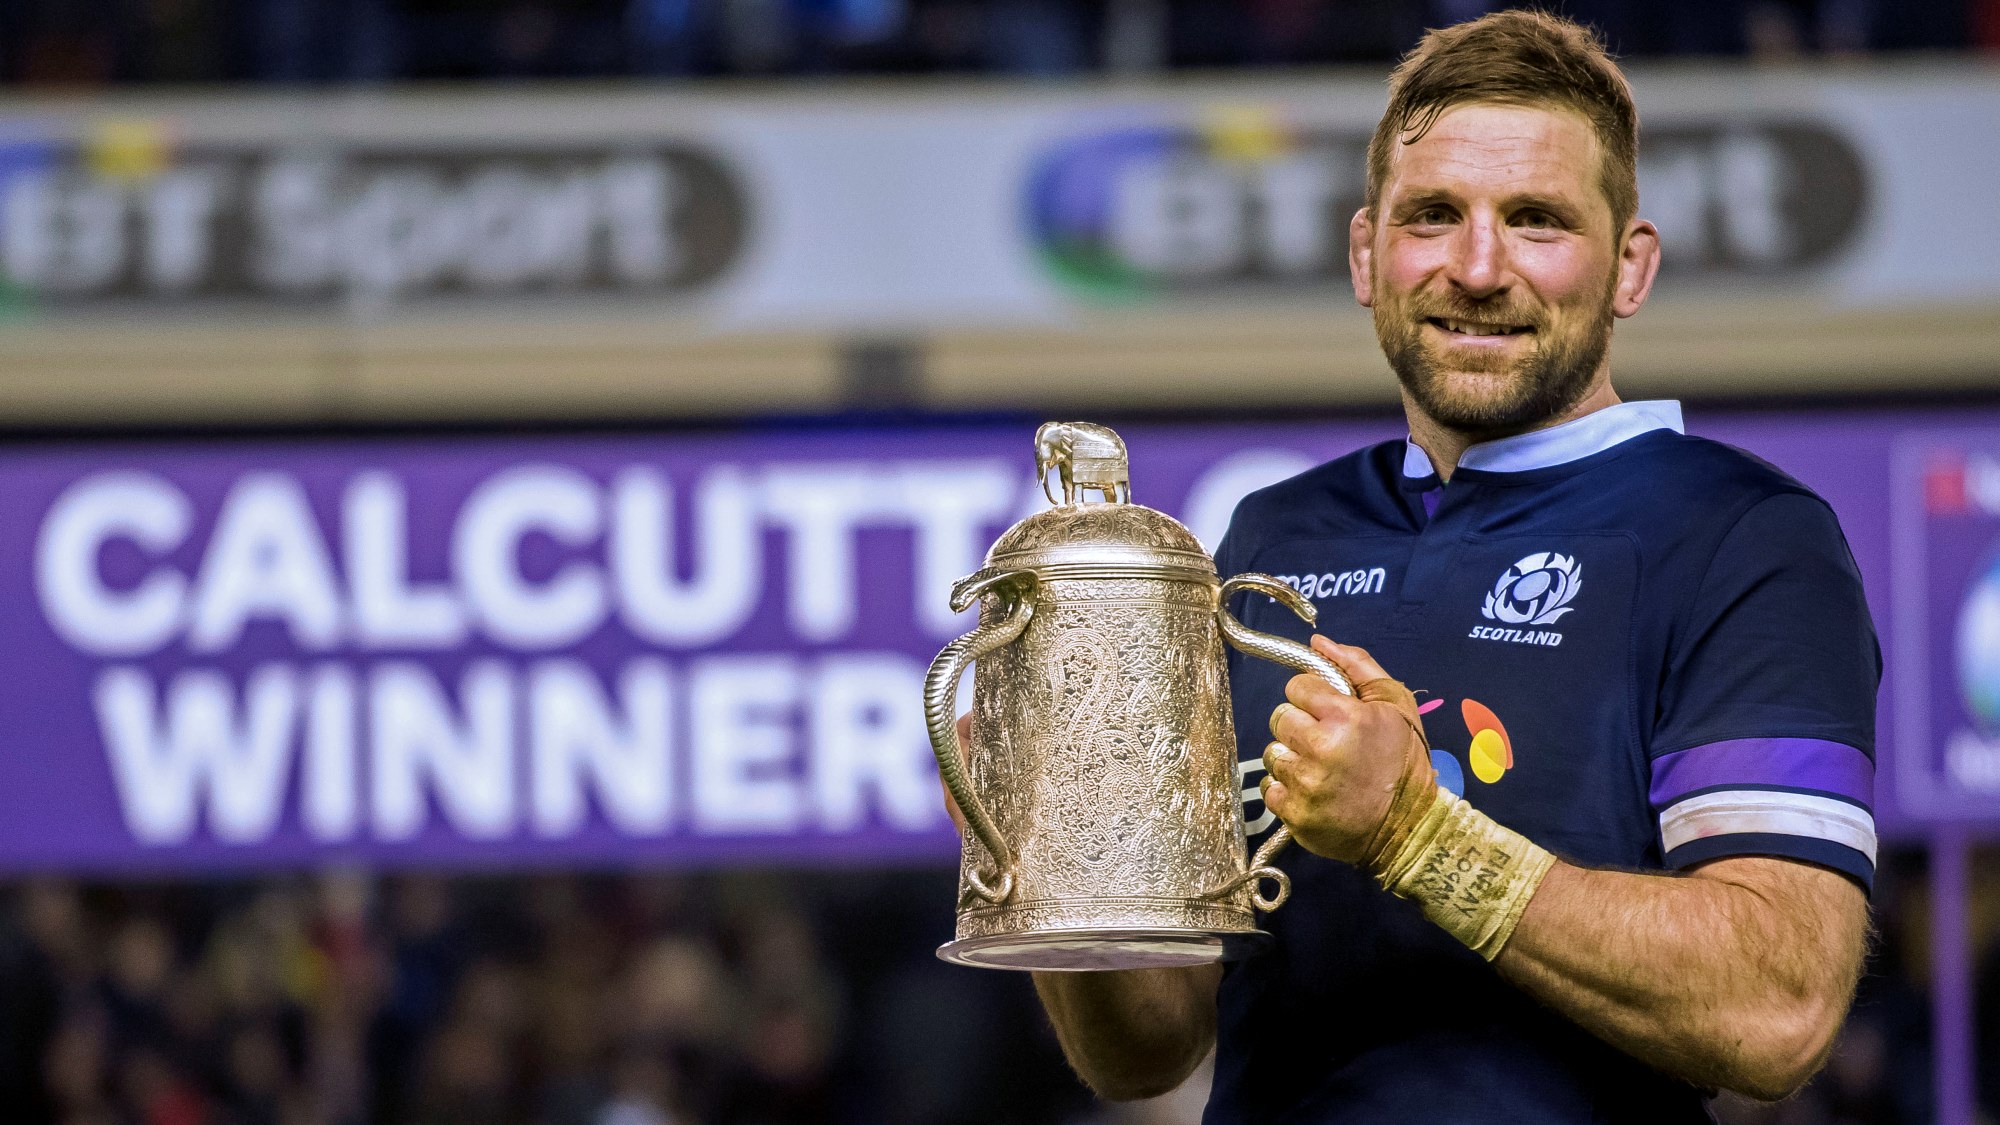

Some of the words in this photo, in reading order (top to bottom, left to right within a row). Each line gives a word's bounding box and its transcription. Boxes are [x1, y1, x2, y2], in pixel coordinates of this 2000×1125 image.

[254, 155, 680, 312] Sport
[35, 460, 1108, 655] CALCUTT
[1468, 625, 1563, 647] SCOTLAND
[95, 655, 975, 843] WINNER
